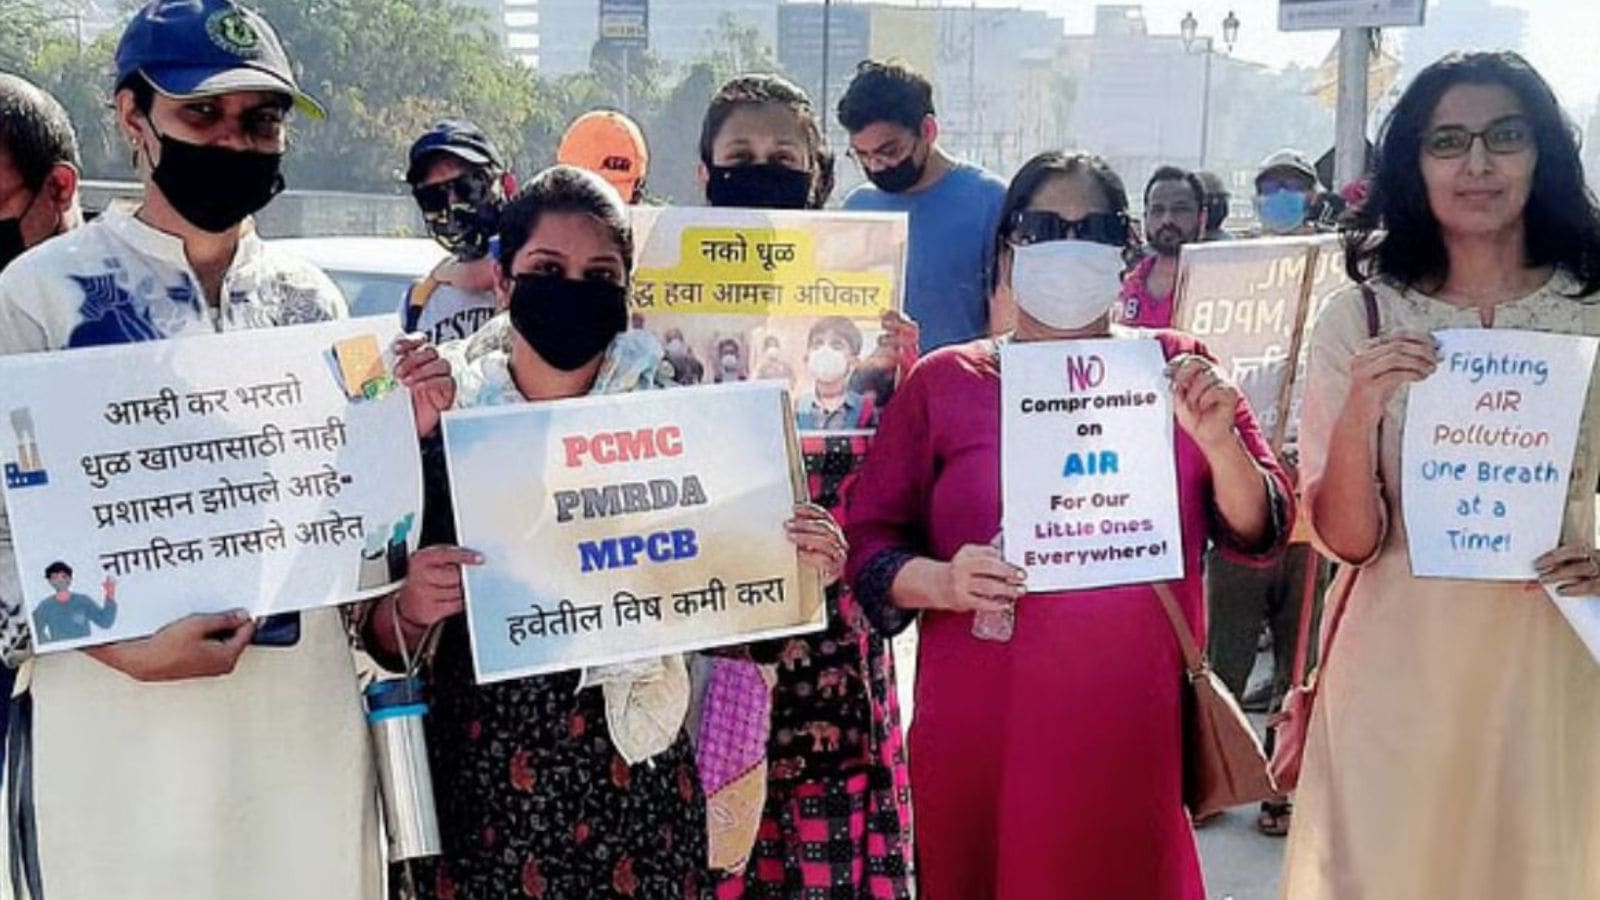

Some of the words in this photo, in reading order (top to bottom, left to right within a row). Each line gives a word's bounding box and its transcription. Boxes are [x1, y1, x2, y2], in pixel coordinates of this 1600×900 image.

[701, 233, 747, 263] नको
[756, 241, 796, 272] धूळ
[629, 282, 655, 308] द्ध
[664, 282, 703, 306] हवा
[713, 282, 782, 305] आमचा
[795, 278, 880, 307] अधिकार
[1066, 354, 1105, 392] NO
[1450, 351, 1549, 385] Fighting
[104, 387, 179, 426] आम्ही
[186, 389, 229, 416] कर
[235, 373, 302, 408] भरतो
[1021, 390, 1157, 414] Compromise
[1474, 390, 1523, 413] AIR
[1076, 422, 1103, 436] on
[1433, 423, 1550, 449] Pollution
[81, 450, 132, 489] धुळ
[138, 423, 285, 472] खाण्यासाठी
[291, 416, 347, 451] नाही
[562, 426, 683, 467] PCMC
[1062, 450, 1119, 477] AIR
[1421, 459, 1468, 481] One
[1477, 461, 1560, 485] Breath
[92, 491, 194, 528] प्रशासन
[198, 476, 280, 514] झोपले
[553, 474, 707, 523] PMRDA
[1050, 494, 1087, 511] For
[1090, 493, 1131, 508] Our
[1456, 495, 1482, 518] at
[1493, 500, 1507, 518] a
[100, 536, 204, 576] नागरिक
[208, 519, 286, 558] त्रासले
[294, 509, 365, 546] आहेत
[1034, 522, 1094, 540] Little
[1099, 519, 1154, 536] Ones
[1446, 529, 1513, 553] Time!
[578, 528, 698, 573] MPCB
[1024, 541, 1168, 567] Everywhere!
[506, 598, 602, 646] हवेतील
[613, 593, 663, 628] विष
[672, 578, 728, 618] कमी
[734, 576, 786, 605] करा
